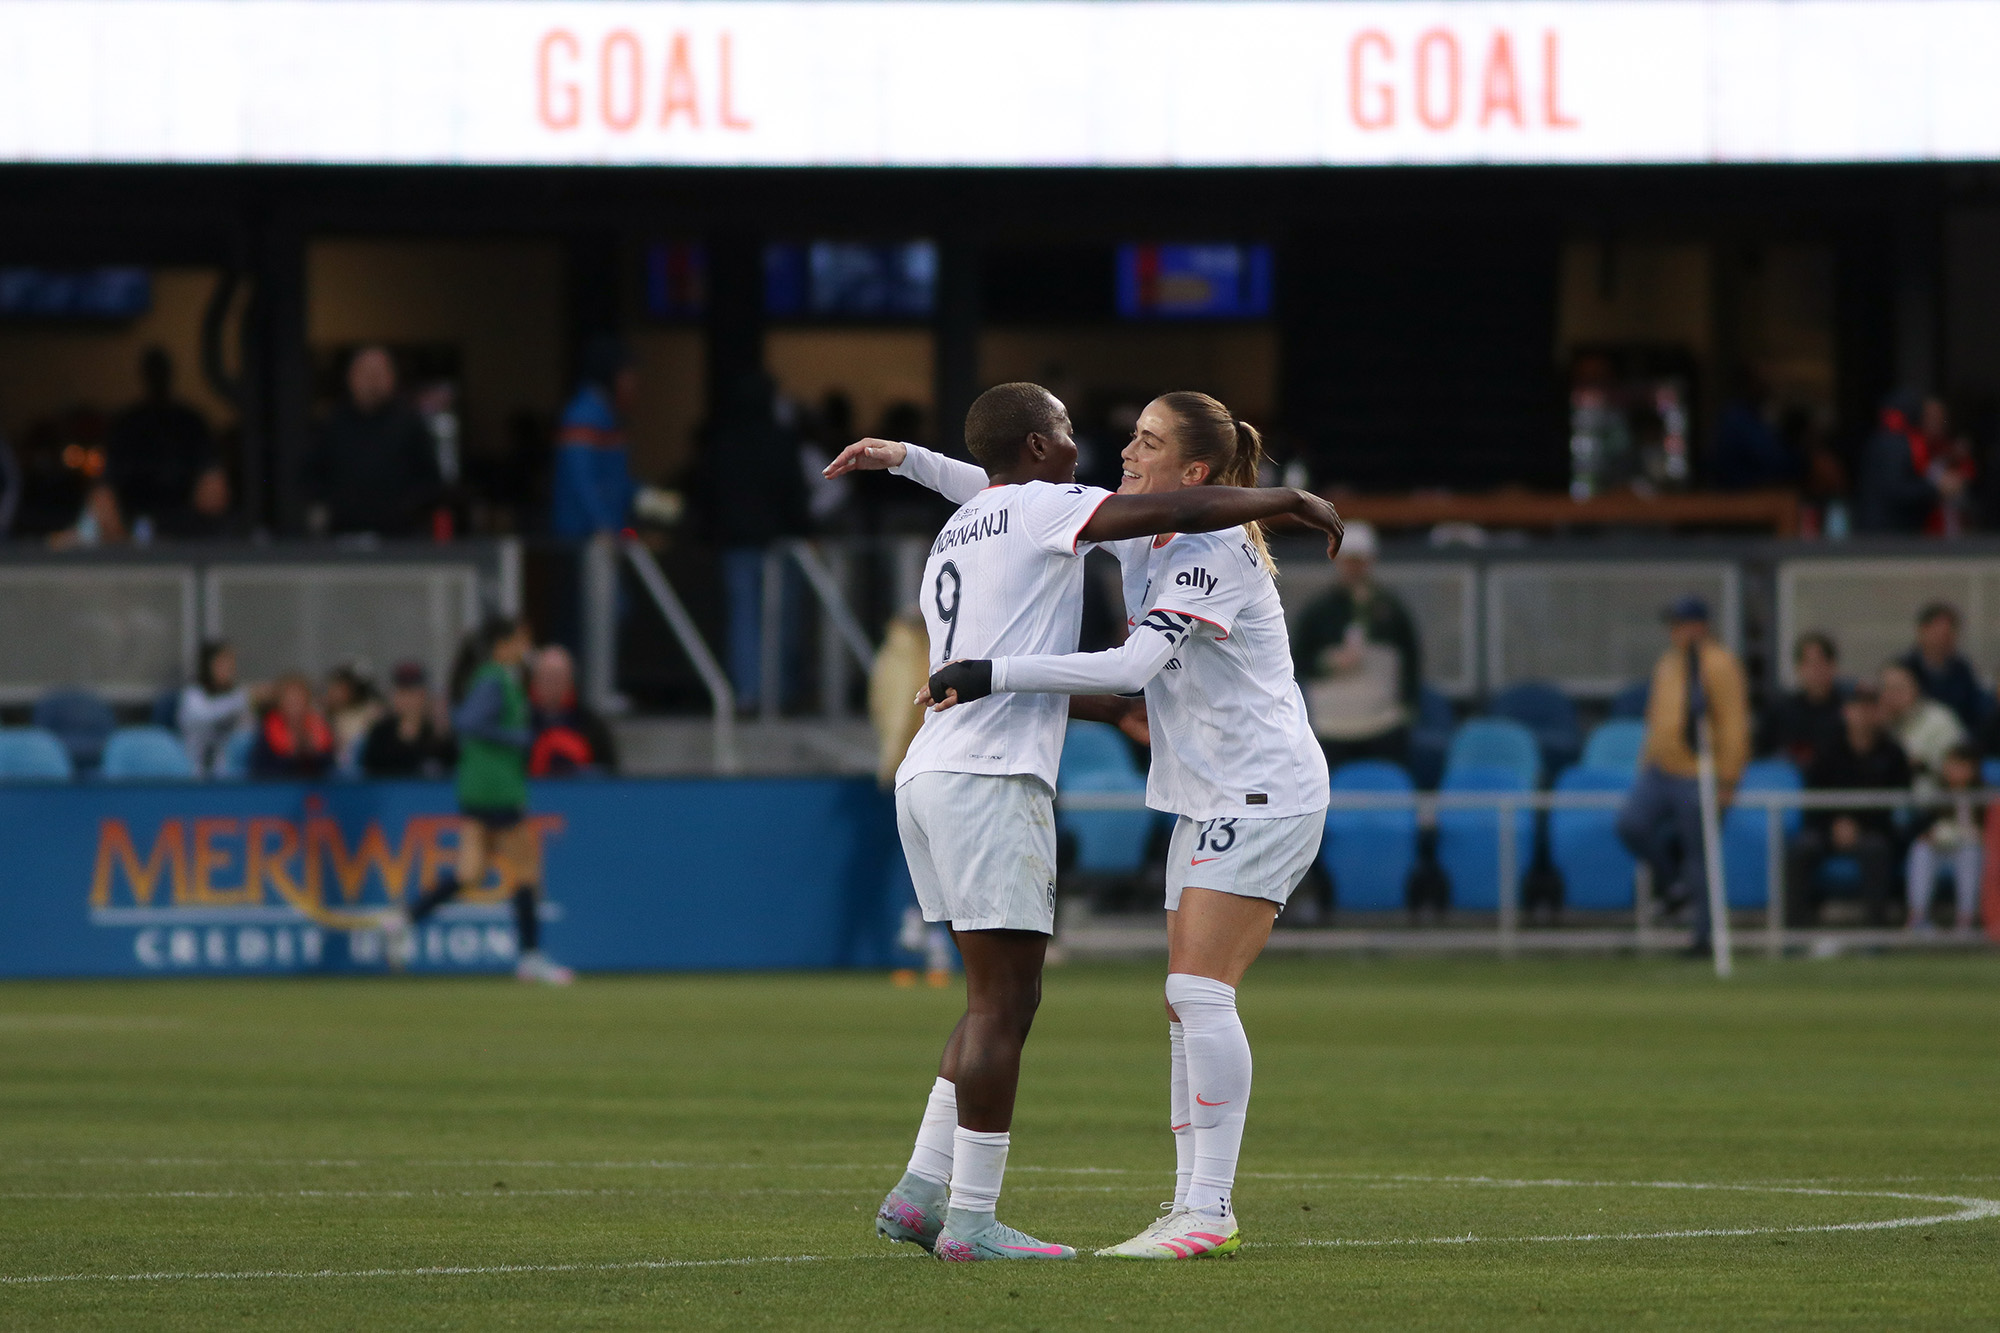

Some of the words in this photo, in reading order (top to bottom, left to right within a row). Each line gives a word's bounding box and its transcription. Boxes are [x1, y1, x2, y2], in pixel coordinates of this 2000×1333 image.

[535, 27, 756, 132] GOAL
[1348, 26, 1583, 132] GOAL
[929, 508, 1008, 558] NDANANJI
[1175, 567, 1218, 596] ally
[936, 559, 961, 663] 9
[1197, 817, 1239, 852] 13
[135, 926, 324, 968] CREDIT
